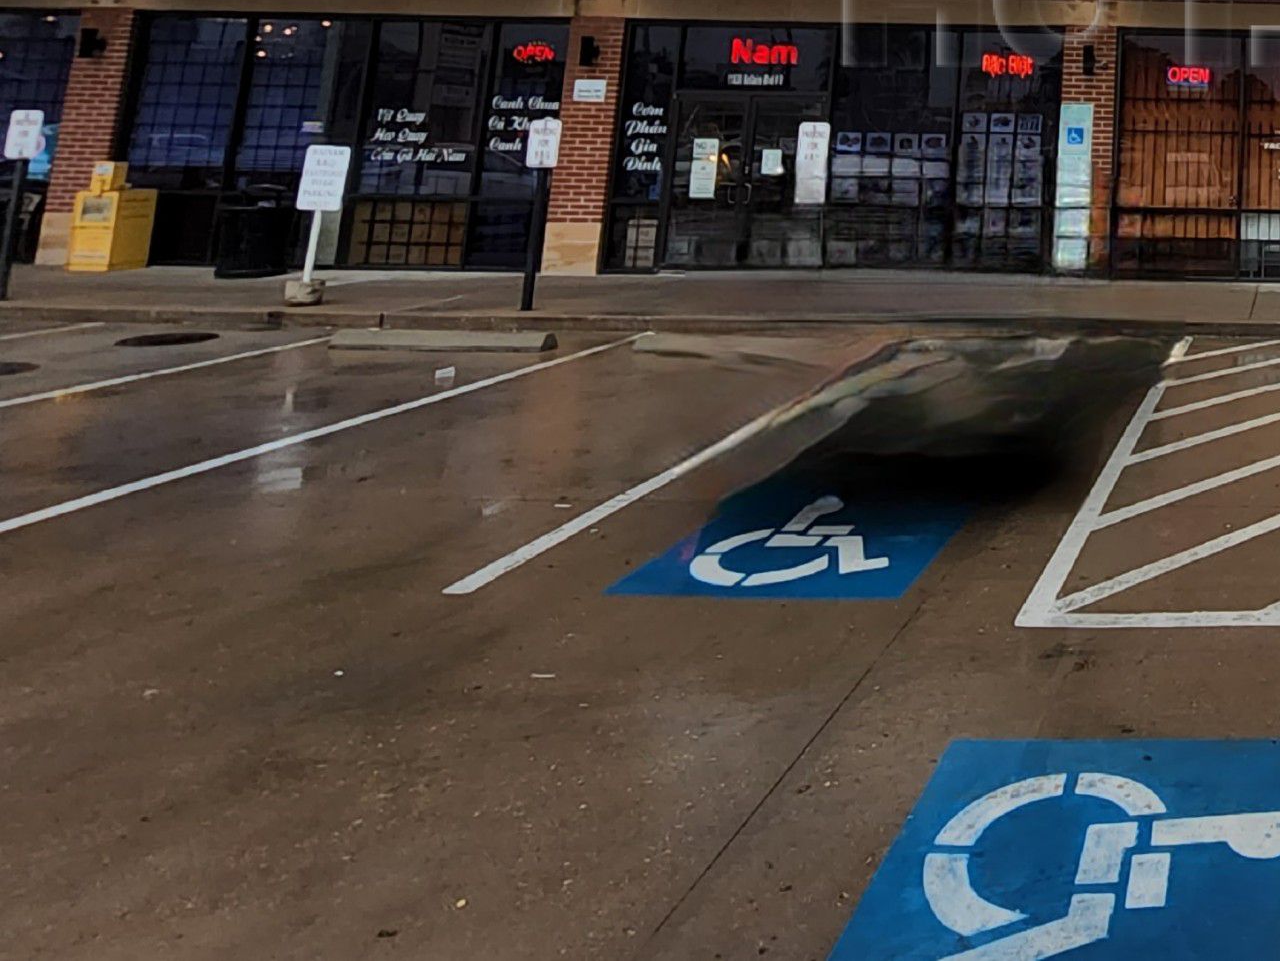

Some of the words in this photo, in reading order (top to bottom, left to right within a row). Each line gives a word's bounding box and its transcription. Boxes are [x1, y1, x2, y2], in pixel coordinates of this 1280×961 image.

[513, 44, 555, 61] OPEN
[731, 37, 798, 65] Nam
[1167, 67, 1210, 83] OPEN
[492, 95, 524, 110] Canh
[528, 96, 560, 110] Chua
[396, 108, 427, 125] Quay
[397, 128, 429, 145] Quay
[489, 136, 523, 150] Canh
[630, 137, 658, 155] Gia
